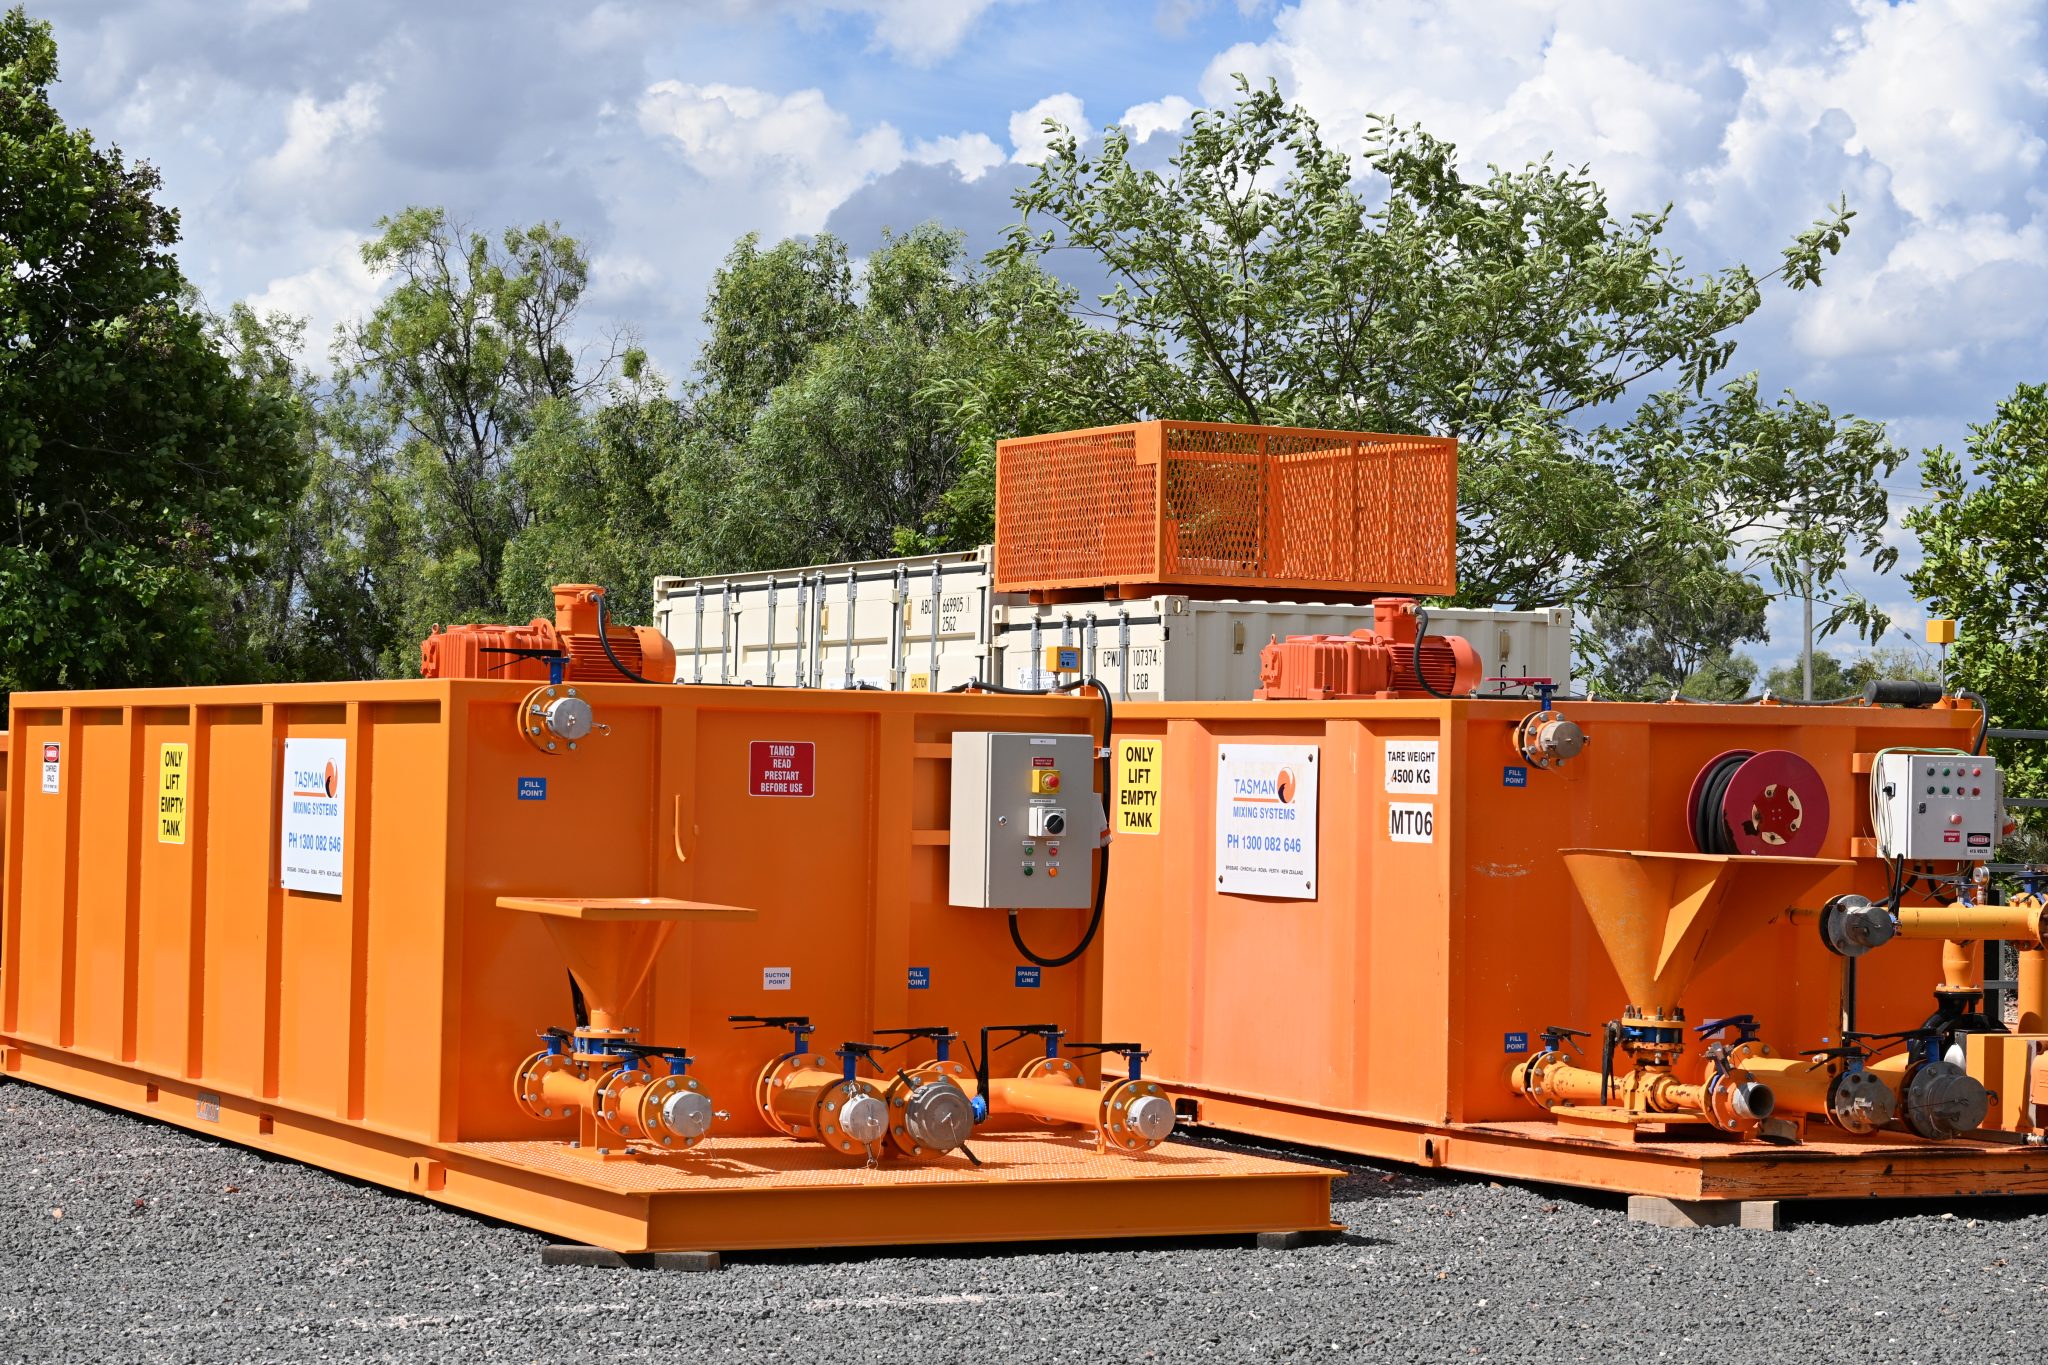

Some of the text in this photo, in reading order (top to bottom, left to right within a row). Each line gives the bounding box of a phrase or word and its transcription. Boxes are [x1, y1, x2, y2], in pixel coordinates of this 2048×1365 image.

[942, 596, 964, 613] 669905
[942, 616, 957, 632] 25G2
[1103, 650, 1120, 668] CPWU
[1132, 649, 1157, 666] 107374
[1132, 673, 1149, 690] 12GB
[165, 750, 183, 767] ONLY
[769, 745, 795, 756] TANGO
[1126, 746, 1154, 763] ONLY
[1387, 751, 1435, 763] TARE WEIGHT
[773, 758, 792, 769] READ
[294, 770, 324, 789] TASMAN
[764, 770, 800, 780] PRESTART
[1128, 768, 1151, 784] LIFT
[1391, 769, 1431, 784] 4500 KG
[1505, 777, 1525, 785] POINT
[1508, 769, 1522, 777] FILL
[165, 774, 180, 790] LIFT
[760, 782, 803, 793] BEFORE USE
[1234, 778, 1276, 795] TASMAN
[520, 789, 544, 797] POINT
[1121, 790, 1157, 806] EMPTY
[161, 796, 184, 813] EMPTY
[293, 801, 338, 817] MIXING SYSTEMS
[1124, 811, 1152, 828] TANK
[1233, 806, 1296, 821] MIXING SYSTEMS
[162, 819, 181, 836] TANK
[1391, 809, 1433, 836] MT06
[288, 832, 342, 853] PH 1300 082 646
[1227, 834, 1302, 853] PH 1300 082 646
